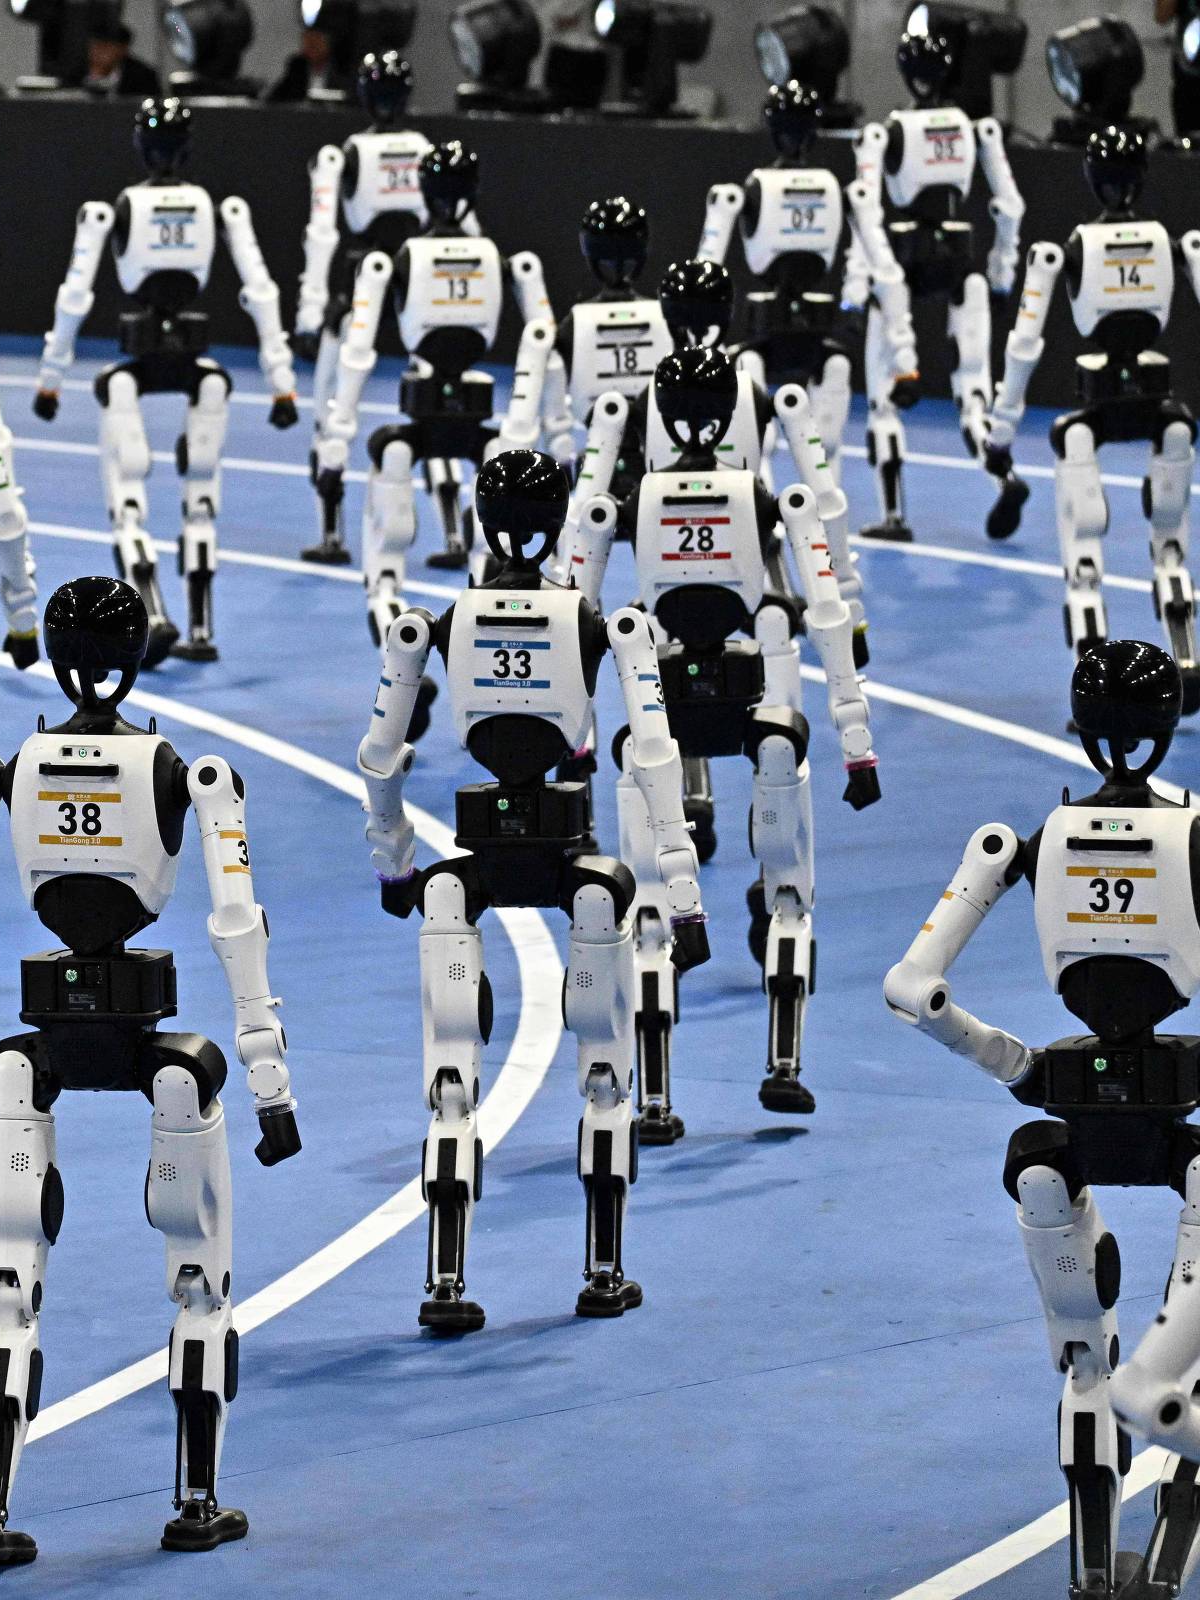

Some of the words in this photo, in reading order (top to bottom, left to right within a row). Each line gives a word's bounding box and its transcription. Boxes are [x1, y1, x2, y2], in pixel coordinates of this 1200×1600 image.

[449, 278, 468, 301] 13
[1118, 265, 1141, 289] 14
[614, 346, 638, 373] 18
[677, 525, 714, 552] 28
[492, 649, 532, 679] 33
[492, 680, 520, 688] TianGong
[58, 802, 102, 836] 38
[60, 837, 89, 845] TianGong
[237, 840, 249, 867] 3
[1088, 878, 1135, 913] 39
[1090, 914, 1122, 923] TianGong
